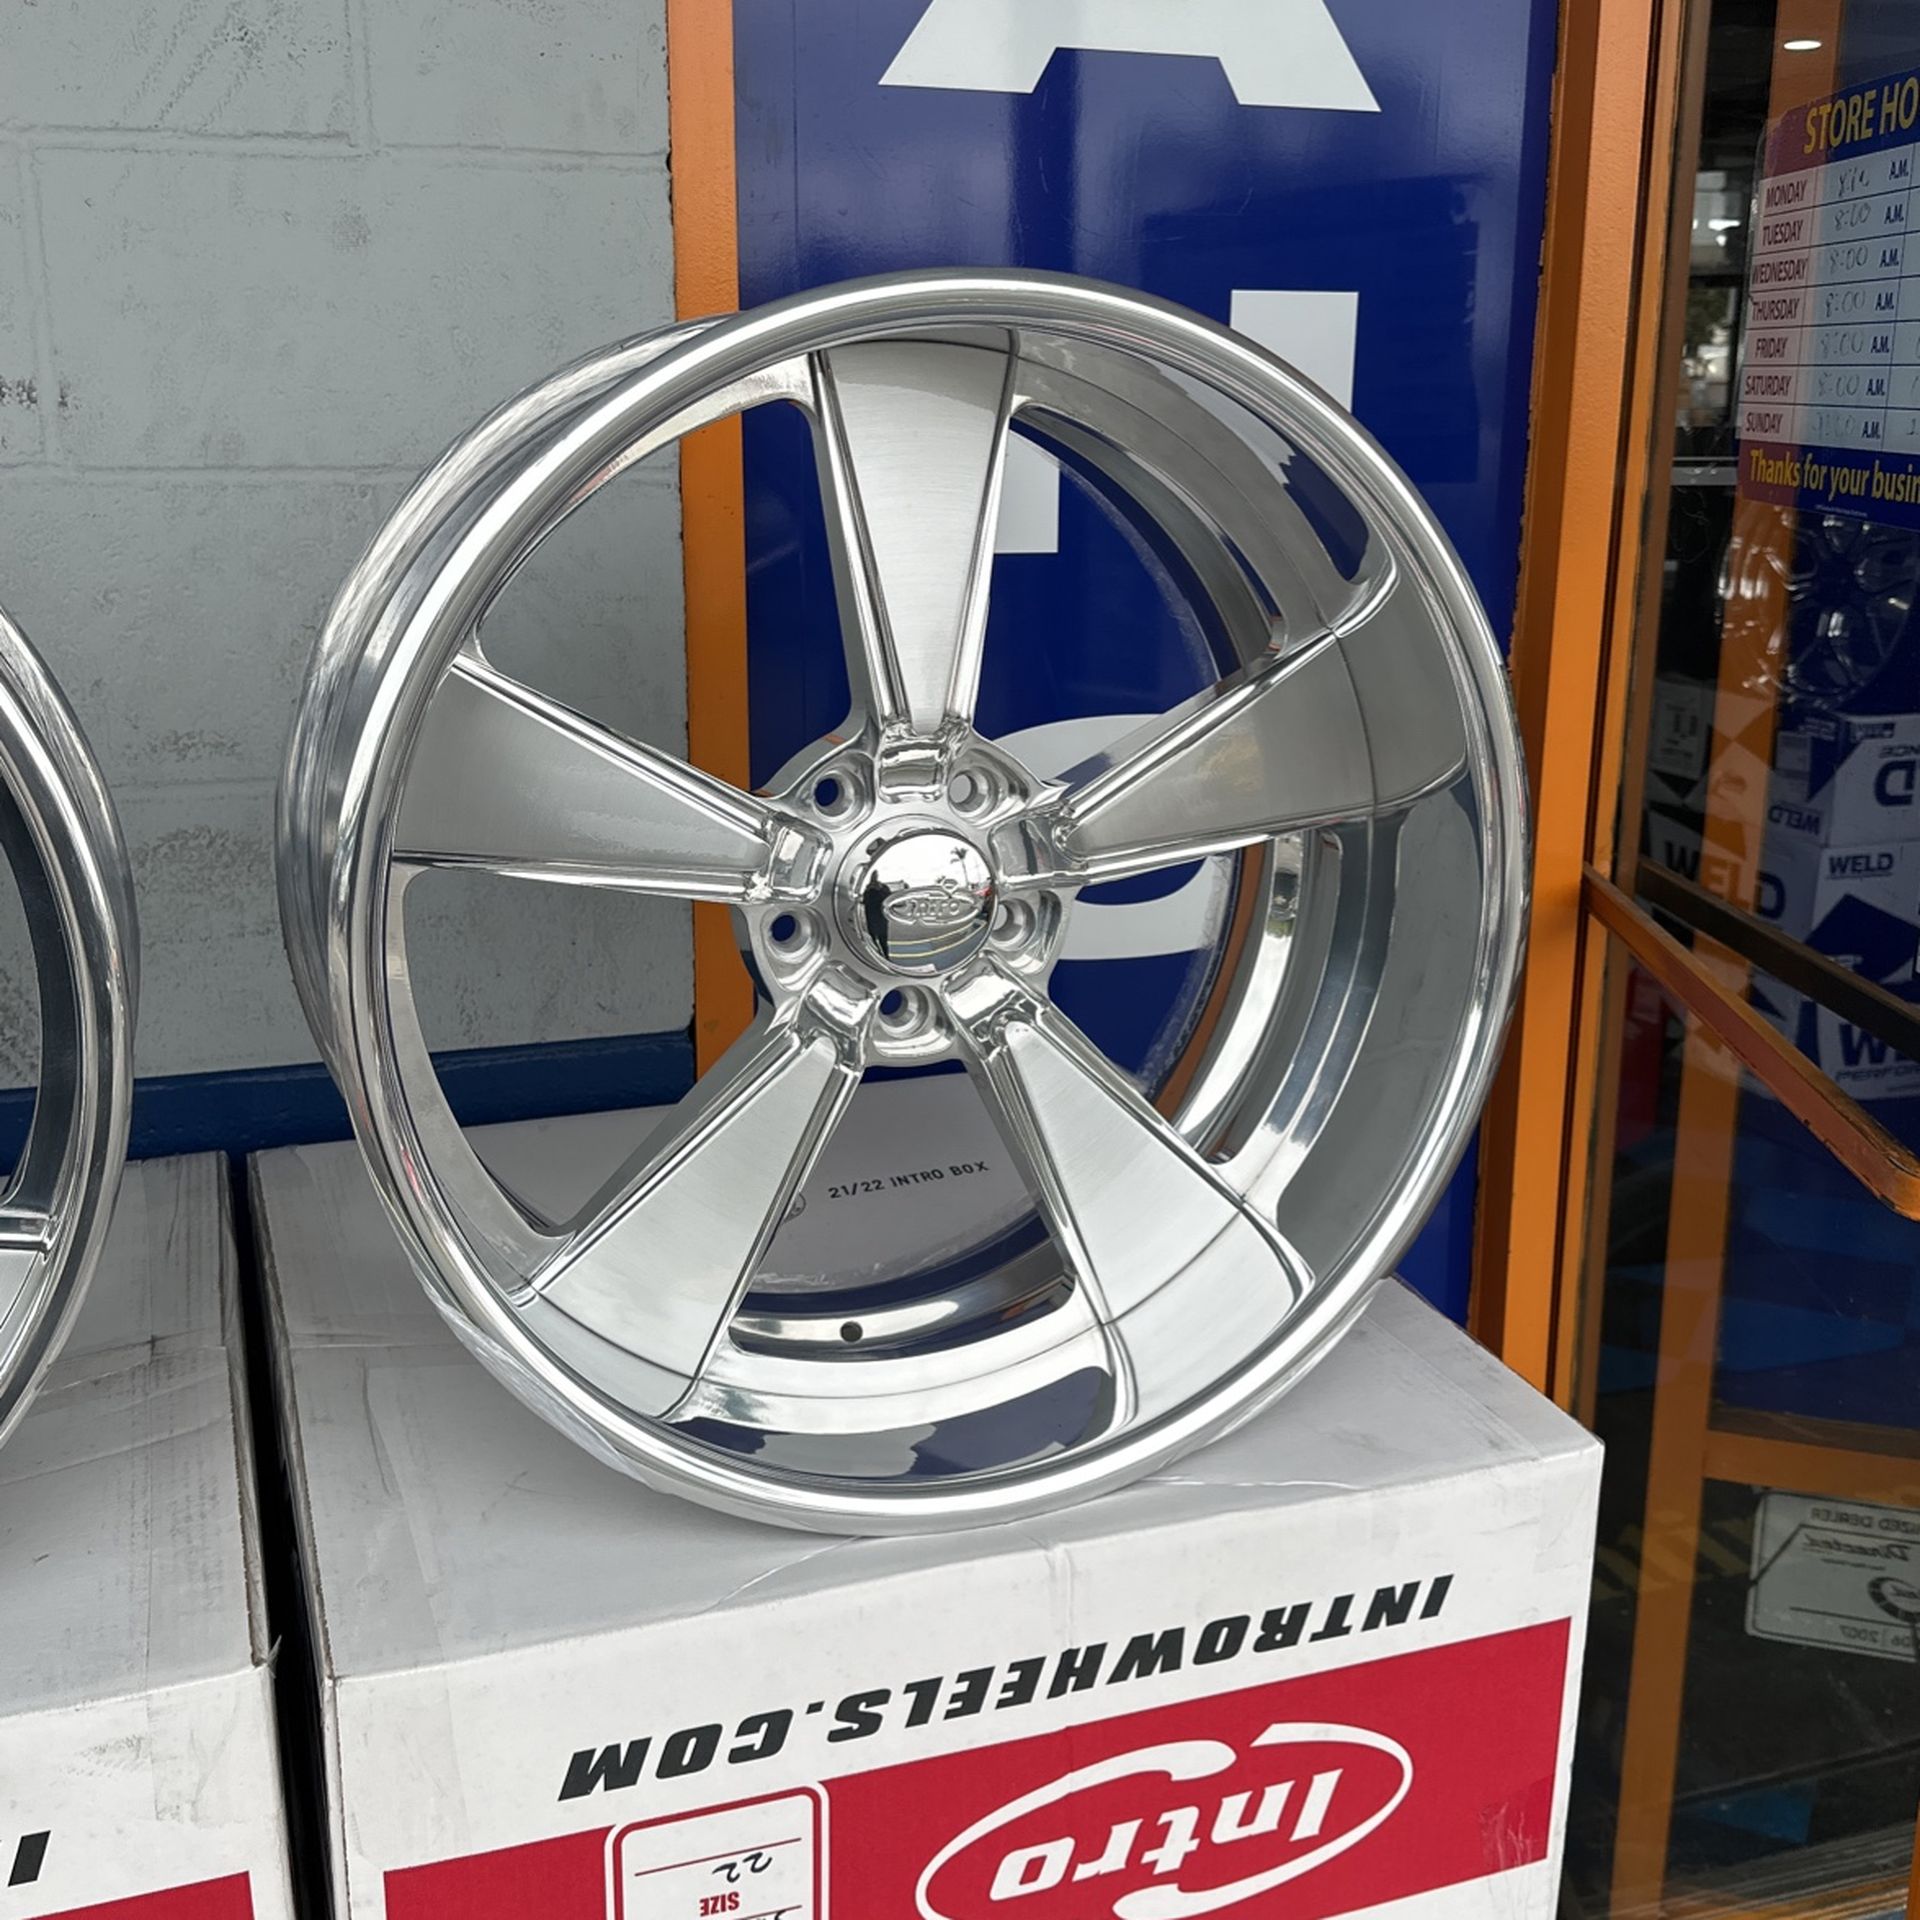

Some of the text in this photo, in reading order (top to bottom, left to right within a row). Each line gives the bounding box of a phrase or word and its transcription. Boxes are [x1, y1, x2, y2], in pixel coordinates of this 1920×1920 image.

[1803, 89, 1877, 154] STORE
[1888, 158, 1909, 181] A.M.
[1765, 179, 1808, 209] MONDAY
[1884, 203, 1905, 225] A.M.
[1762, 219, 1804, 246] TUESDAY
[1878, 248, 1900, 268] A.M.
[1751, 257, 1809, 285] WEDNESDAY
[1752, 298, 1801, 321] THURSDAY
[1875, 291, 1895, 311] A.M.
[1755, 337, 1789, 358] FRIDAY
[1870, 335, 1890, 354] A.M.
[1744, 375, 1792, 397] SATURDAY
[1866, 378, 1886, 396] A.M.
[1746, 412, 1783, 433] SUNDAY
[1861, 420, 1881, 439] A.M.
[1750, 449, 1801, 487] Thanks
[1802, 452, 1827, 485] for
[1829, 466, 1868, 501] your
[1769, 800, 1821, 836] WELD
[1828, 853, 1894, 875] WELD
[828, 1160, 991, 1200] 21/22 INTRO BOX
[557, 1574, 1454, 1801] INTROWHEELS.COM
[988, 1768, 1344, 1902] Intro
[711, 1851, 773, 1883] 22
[699, 1891, 740, 1917] SIZE
